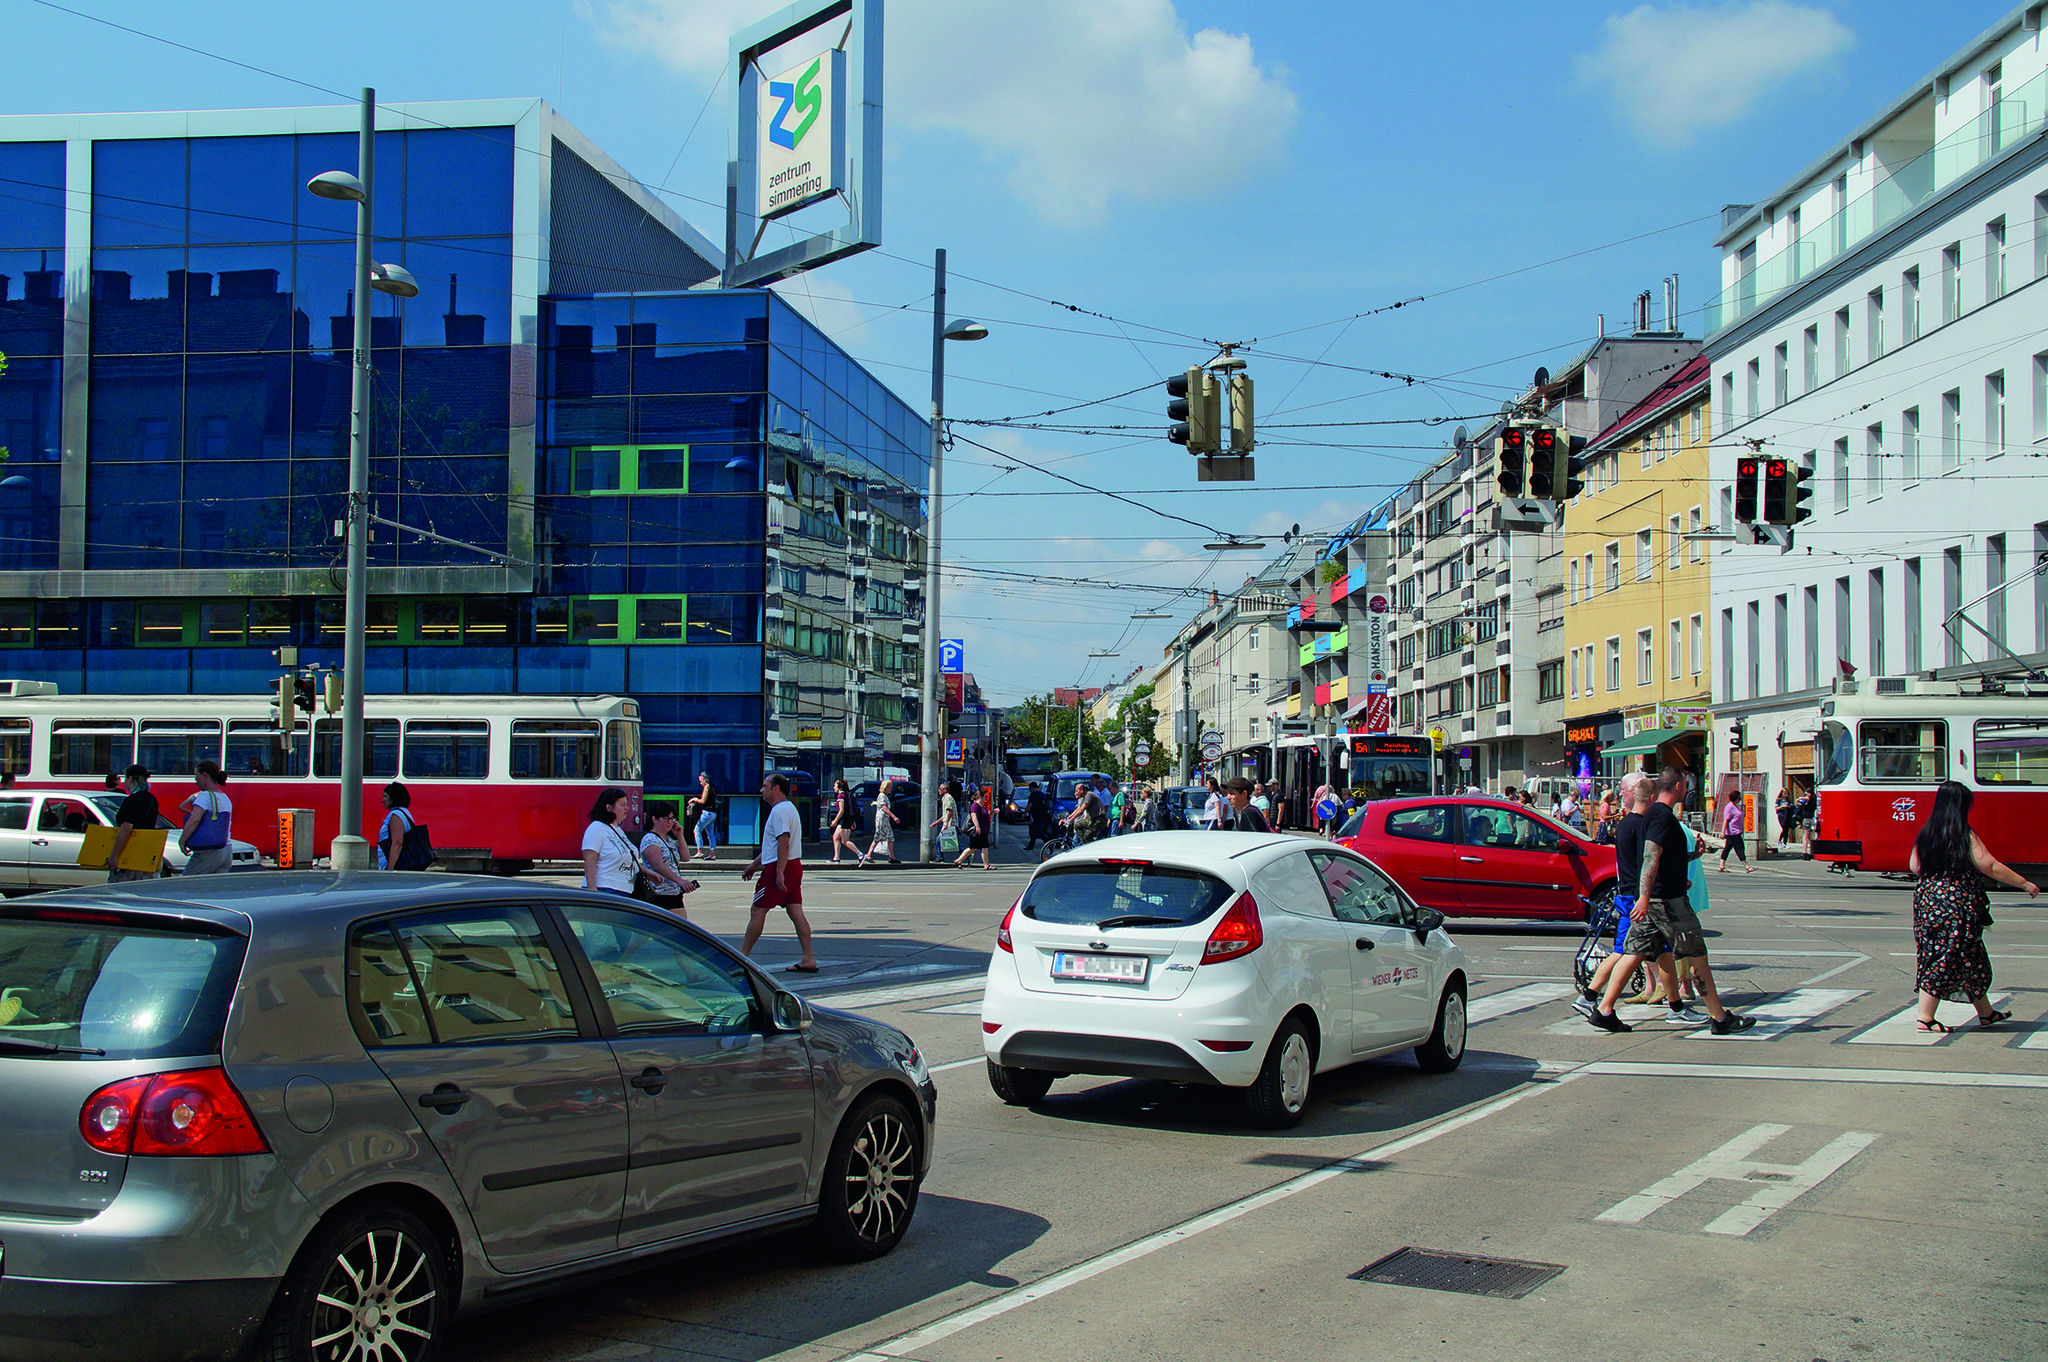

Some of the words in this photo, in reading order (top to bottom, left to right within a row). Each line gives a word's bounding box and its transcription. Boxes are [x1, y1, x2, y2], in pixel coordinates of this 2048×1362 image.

[769, 160, 811, 188] zentrum
[768, 176, 822, 207] simmering
[1371, 616, 1381, 669] HANSATON
[943, 647, 957, 666] P
[1368, 698, 1389, 729] KELLNER
[1355, 742, 1368, 753] 15A
[1892, 811, 1916, 821] 4315
[1371, 972, 1392, 986] WIENER
[1403, 967, 1419, 980] NETZE
[79, 1169, 108, 1183] SDI
